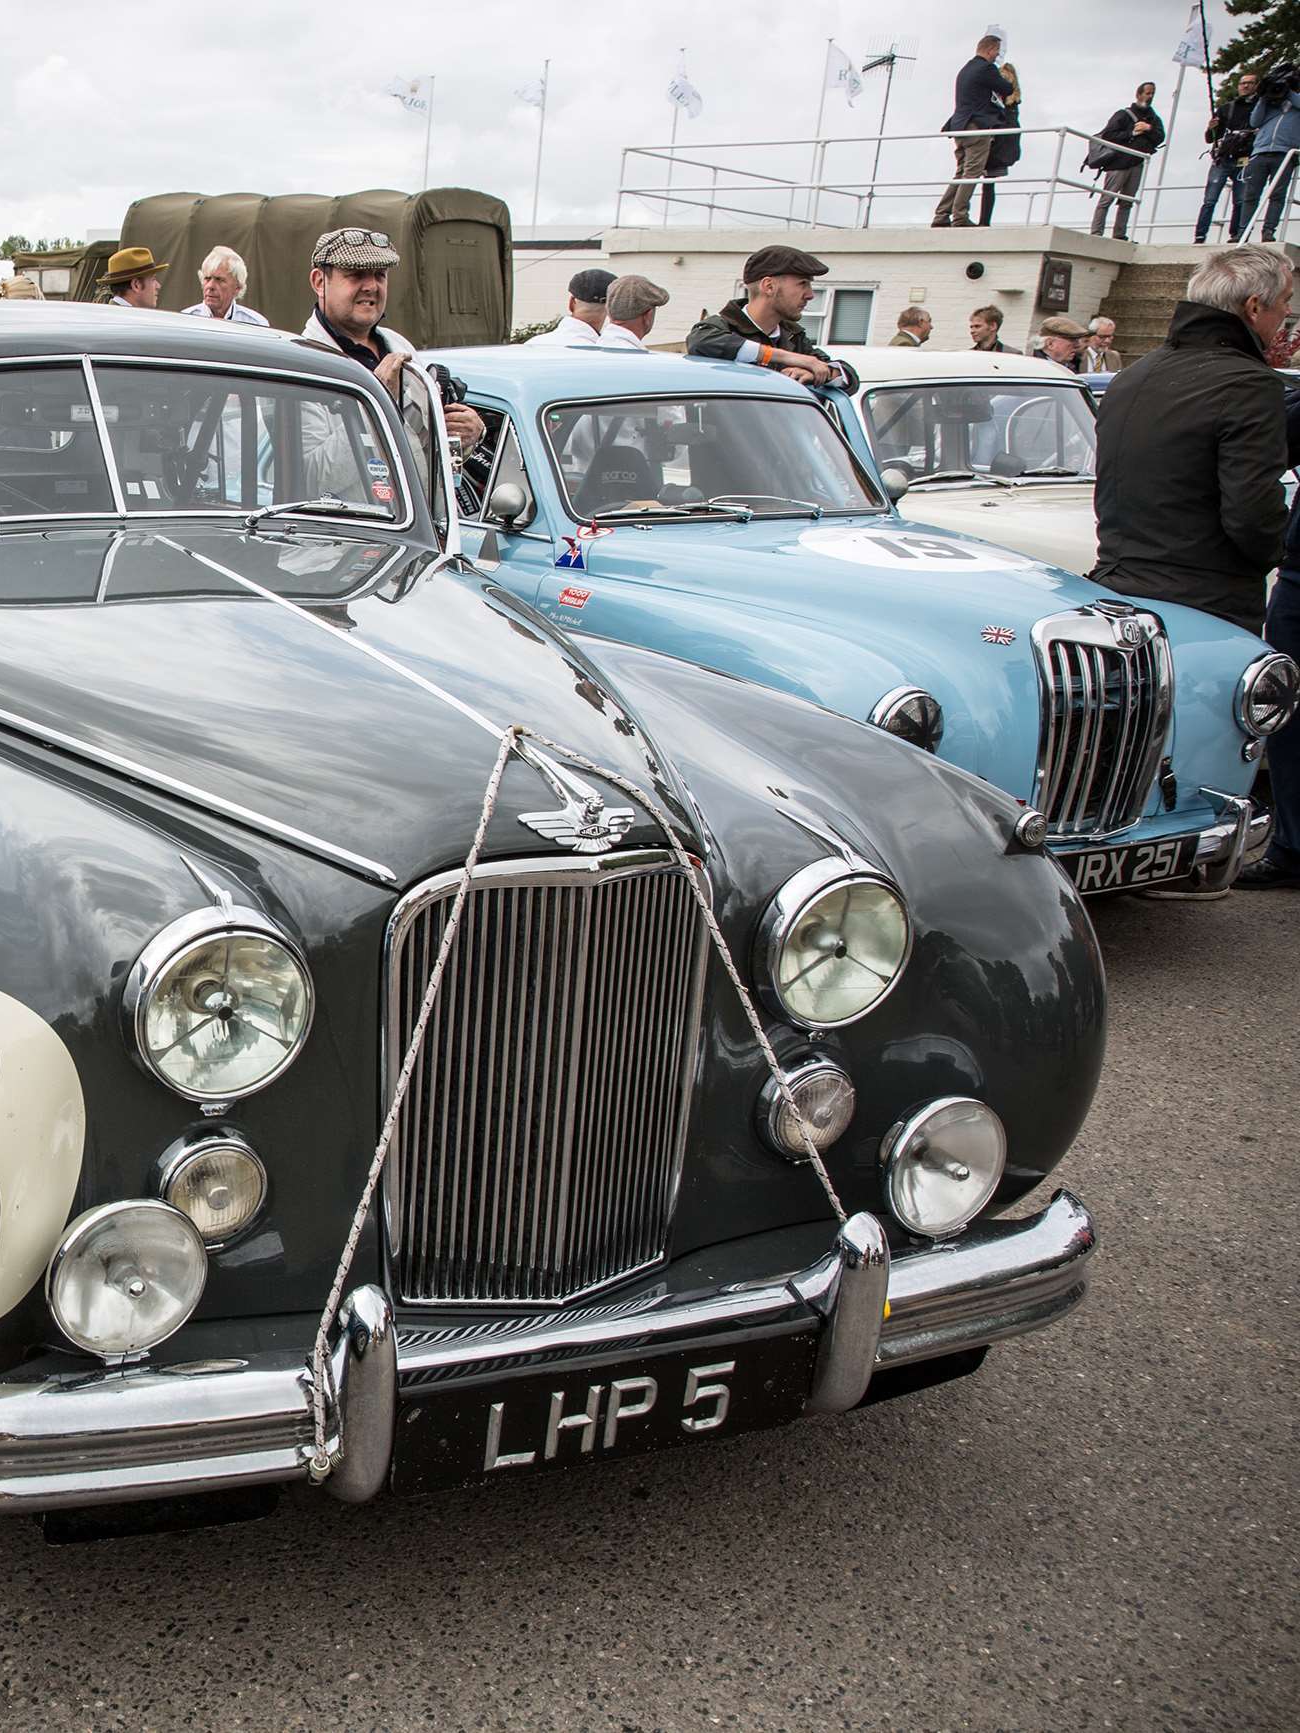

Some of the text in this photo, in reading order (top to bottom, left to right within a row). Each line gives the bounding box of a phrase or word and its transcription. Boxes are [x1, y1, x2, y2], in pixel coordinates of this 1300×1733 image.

[1131, 841, 1182, 882] 251
[483, 1360, 737, 1472] LHP 5
